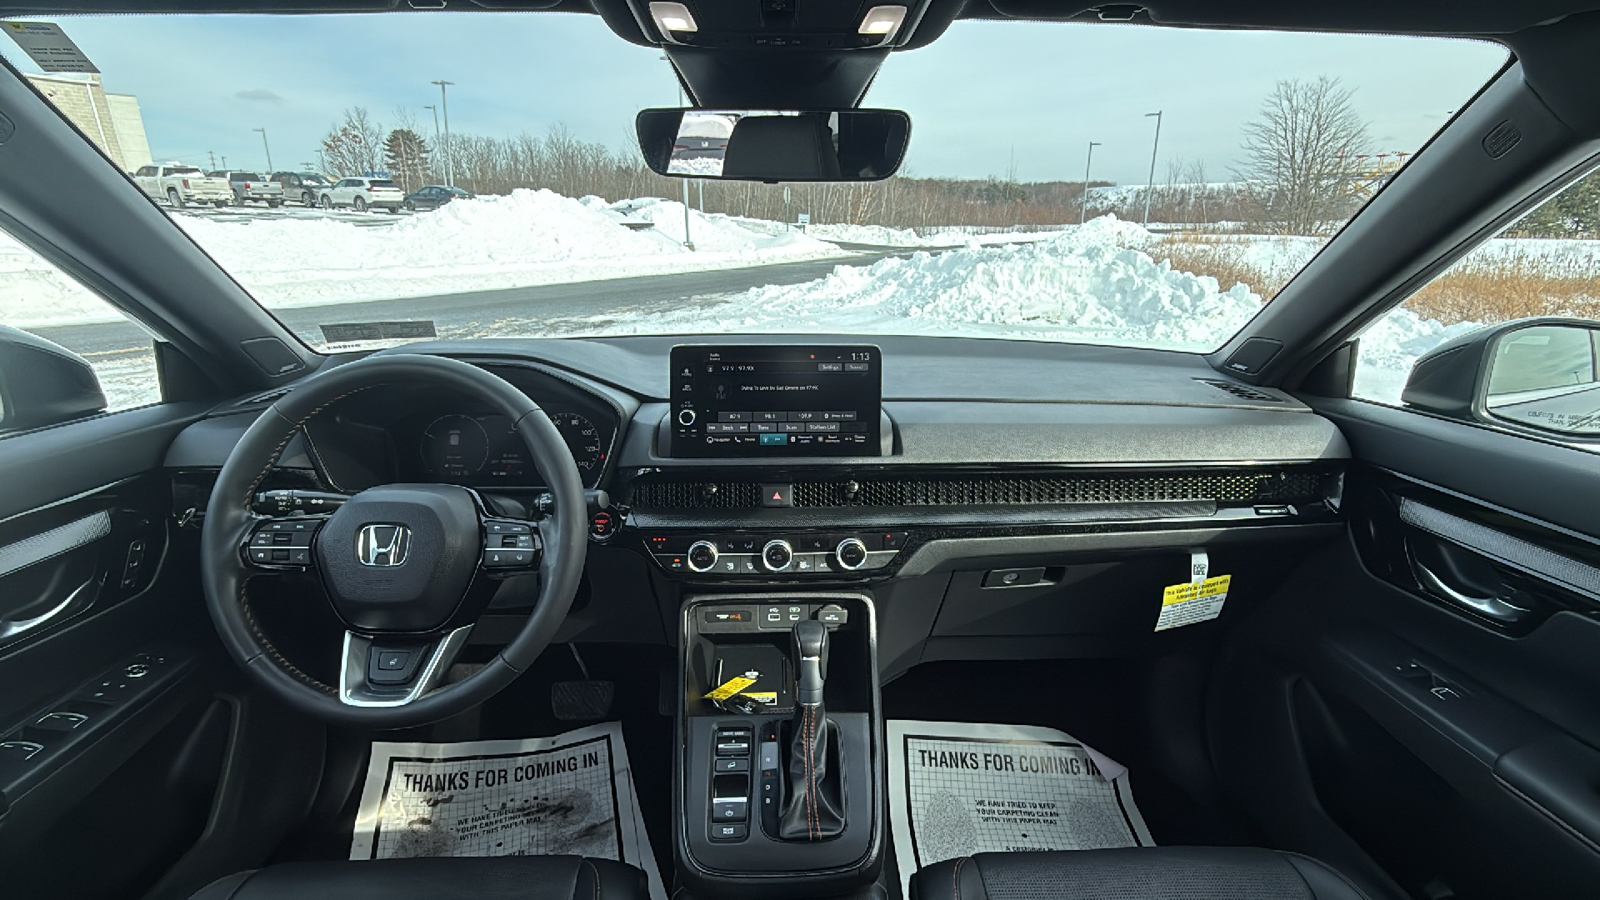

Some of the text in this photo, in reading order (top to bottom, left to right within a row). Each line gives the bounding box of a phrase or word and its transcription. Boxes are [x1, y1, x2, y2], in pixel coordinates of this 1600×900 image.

[851, 352, 870, 361] 1:13
[918, 749, 979, 770] THANKS
[983, 753, 1015, 772] FOR
[1019, 755, 1081, 775] COMING
[403, 751, 599, 793] THANKS FOR COMING IN
[974, 799, 987, 807] WE
[987, 800, 1006, 808] HAVE
[1006, 801, 1027, 809] TRIED
[1038, 802, 1056, 810] KEEP
[976, 808, 1059, 818] YOUR CARPETING CLEAN
[457, 817, 469, 826] WE
[471, 813, 491, 823] HAVE
[456, 825, 478, 834] YOUR
[459, 832, 479, 841] WITH
[482, 826, 499, 836] THIS
[500, 819, 524, 831] PAPER
